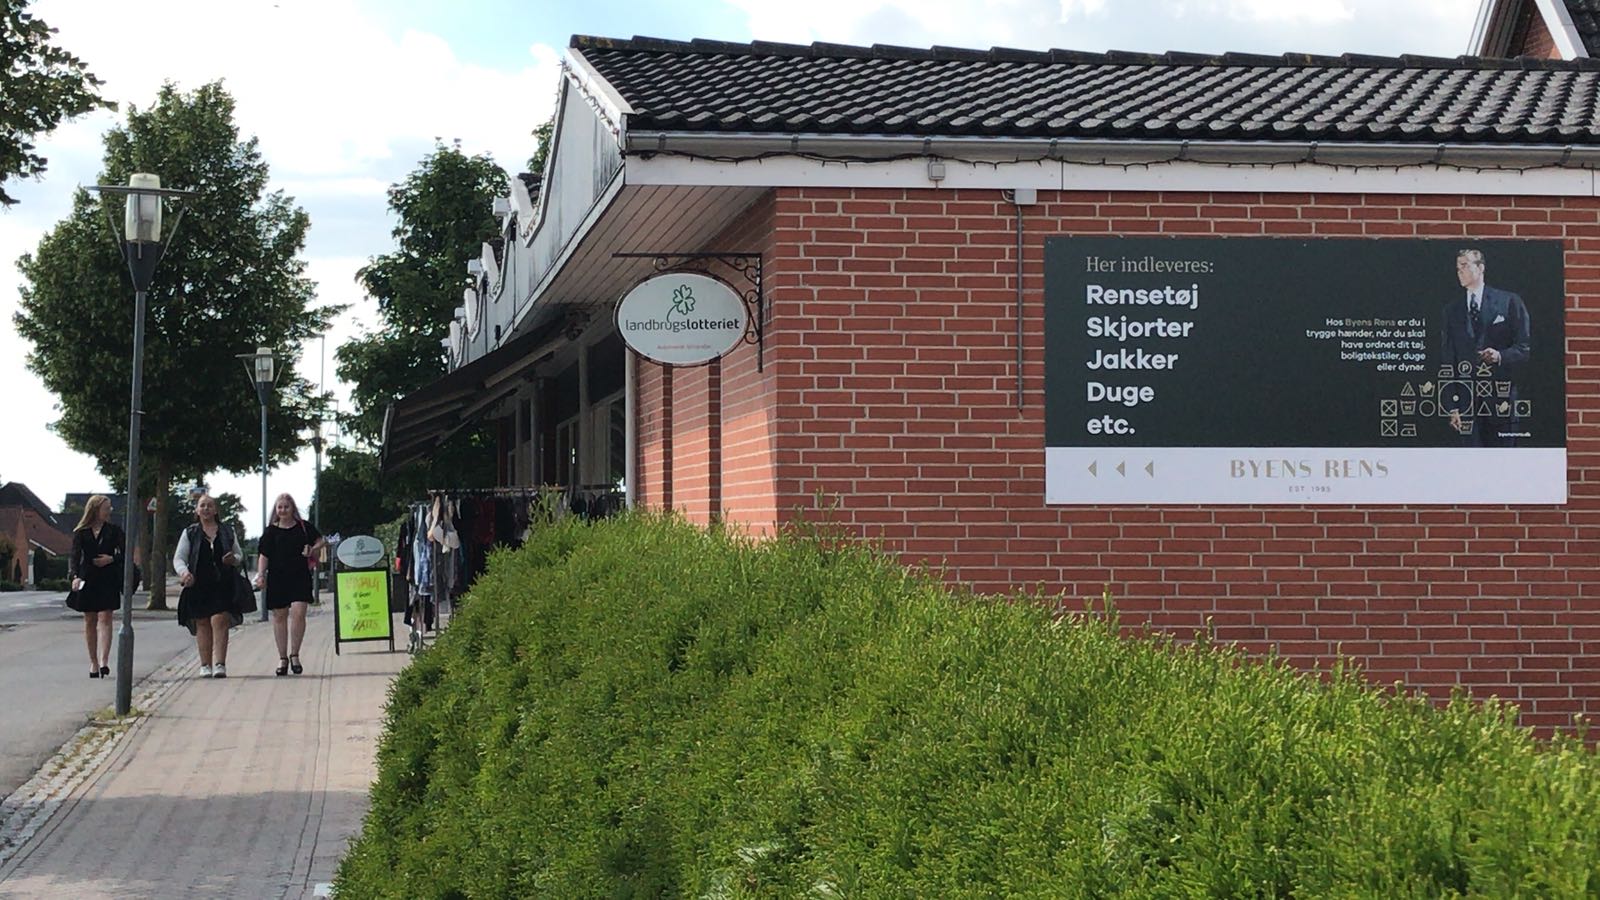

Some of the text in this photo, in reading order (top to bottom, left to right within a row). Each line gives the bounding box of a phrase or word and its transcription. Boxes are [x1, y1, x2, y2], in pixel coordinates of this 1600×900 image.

[1086, 256, 1215, 273] Her indleveres:
[1086, 283, 1199, 310] Rensetøj
[625, 318, 740, 333] landbrugslotteriet
[1086, 315, 1194, 342] Skjorter
[1325, 318, 1344, 327] Hos
[1408, 318, 1421, 327] du
[1306, 329, 1336, 339] trygge
[1376, 329, 1392, 338] når
[1393, 329, 1406, 338] du
[1407, 329, 1426, 338] skal
[1341, 340, 1364, 349] have
[1365, 340, 1396, 349] ordnet
[1396, 340, 1410, 349] dit
[1086, 348, 1179, 370] Jakker
[1402, 351, 1426, 361] duge
[1376, 363, 1396, 371] eller
[1087, 381, 1155, 407] Duge
[1087, 414, 1136, 435] etc.
[1230, 459, 1389, 478] BYENS RENS
